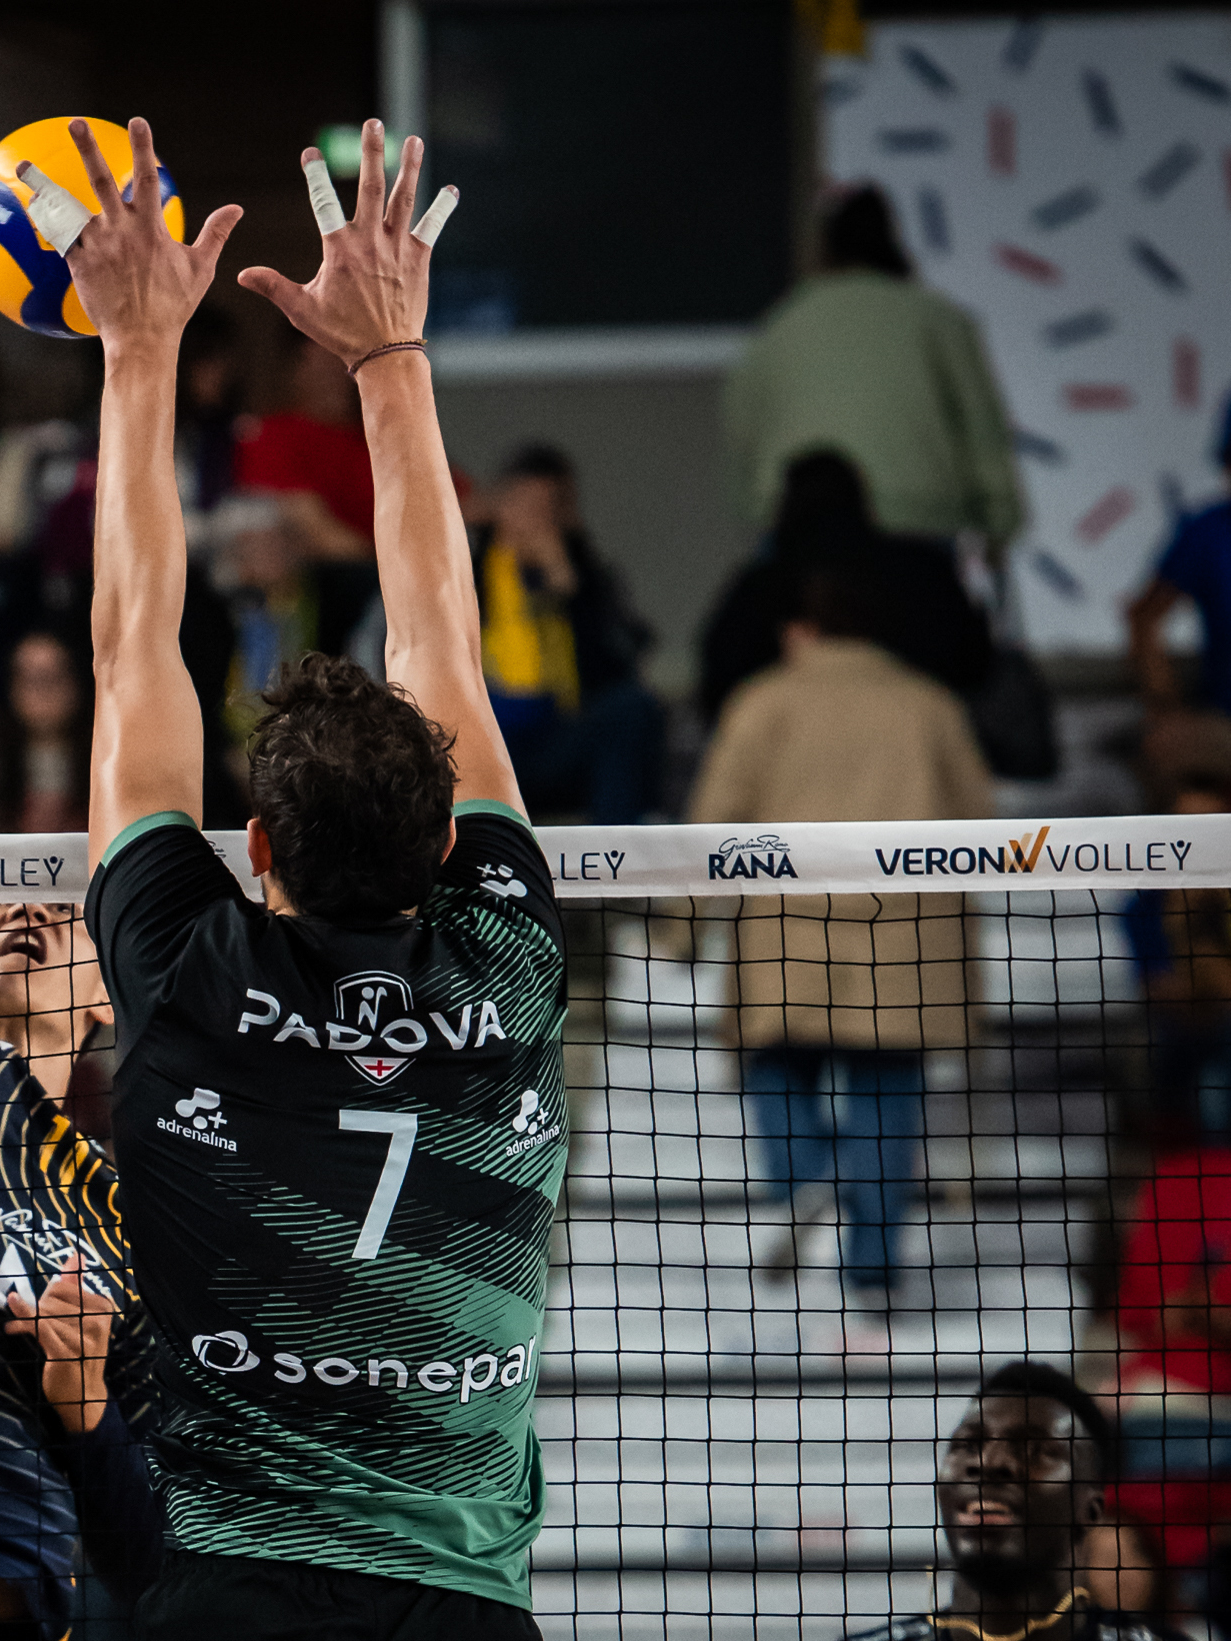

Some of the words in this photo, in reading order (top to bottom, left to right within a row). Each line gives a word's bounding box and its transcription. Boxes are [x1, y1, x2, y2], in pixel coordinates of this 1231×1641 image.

[551, 850, 626, 881] LEY
[708, 853, 799, 879] RANA
[1046, 840, 1192, 873] VOLLEY
[237, 988, 508, 1052] PADOVA
[156, 1117, 237, 1152] adrenalina
[505, 1124, 560, 1157] adrenalina
[338, 1108, 419, 1260] 7
